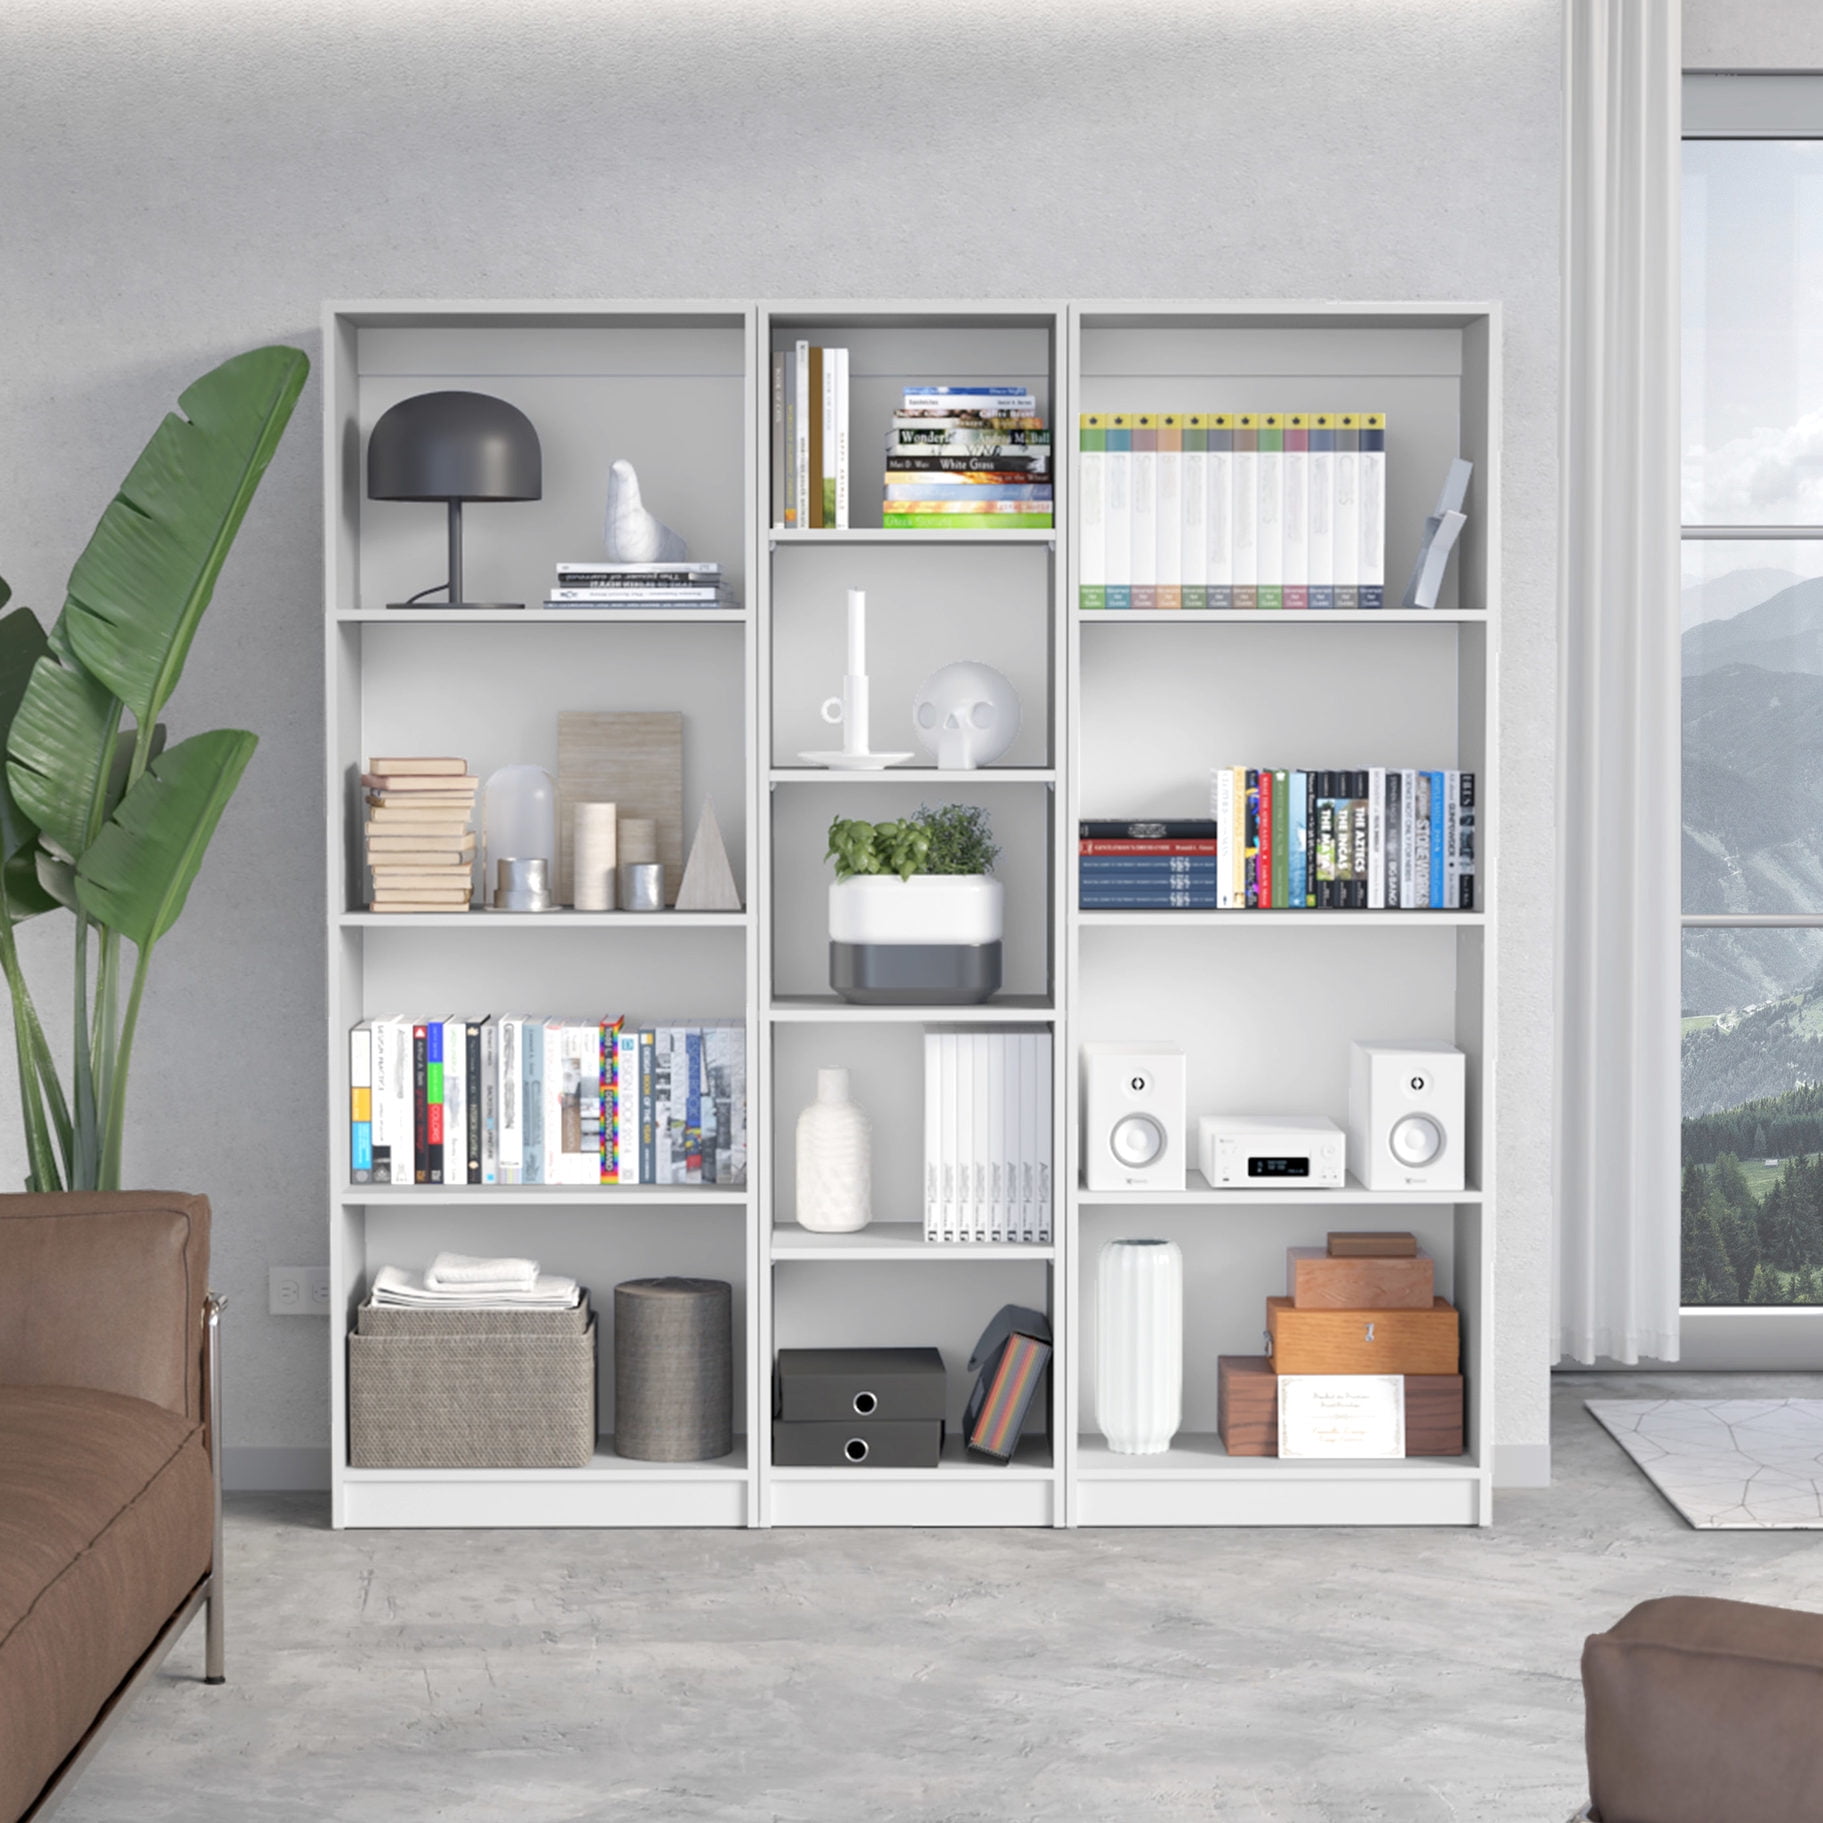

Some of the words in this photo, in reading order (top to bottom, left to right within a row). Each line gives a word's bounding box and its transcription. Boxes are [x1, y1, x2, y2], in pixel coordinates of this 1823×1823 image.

[940, 458, 966, 470] White
[970, 458, 994, 470] Grass
[1321, 809, 1331, 831] THE
[1338, 810, 1347, 830] THE
[1355, 807, 1365, 827] THE
[1321, 834, 1331, 869] MAYA
[1338, 833, 1347, 869] INCAS
[1355, 830, 1365, 872] AZTECS
[1416, 819, 1430, 905] STONEWORKS
[622, 1053, 632, 1090] DESIGN
[643, 1047, 651, 1073] DESIGN
[605, 1090, 613, 1139] DESIGNING
[622, 1094, 632, 1124] BOOK
[643, 1097, 651, 1107] OF
[643, 1109, 651, 1123] THE
[643, 1125, 651, 1143] YEAR
[605, 1141, 613, 1170] BRAND
